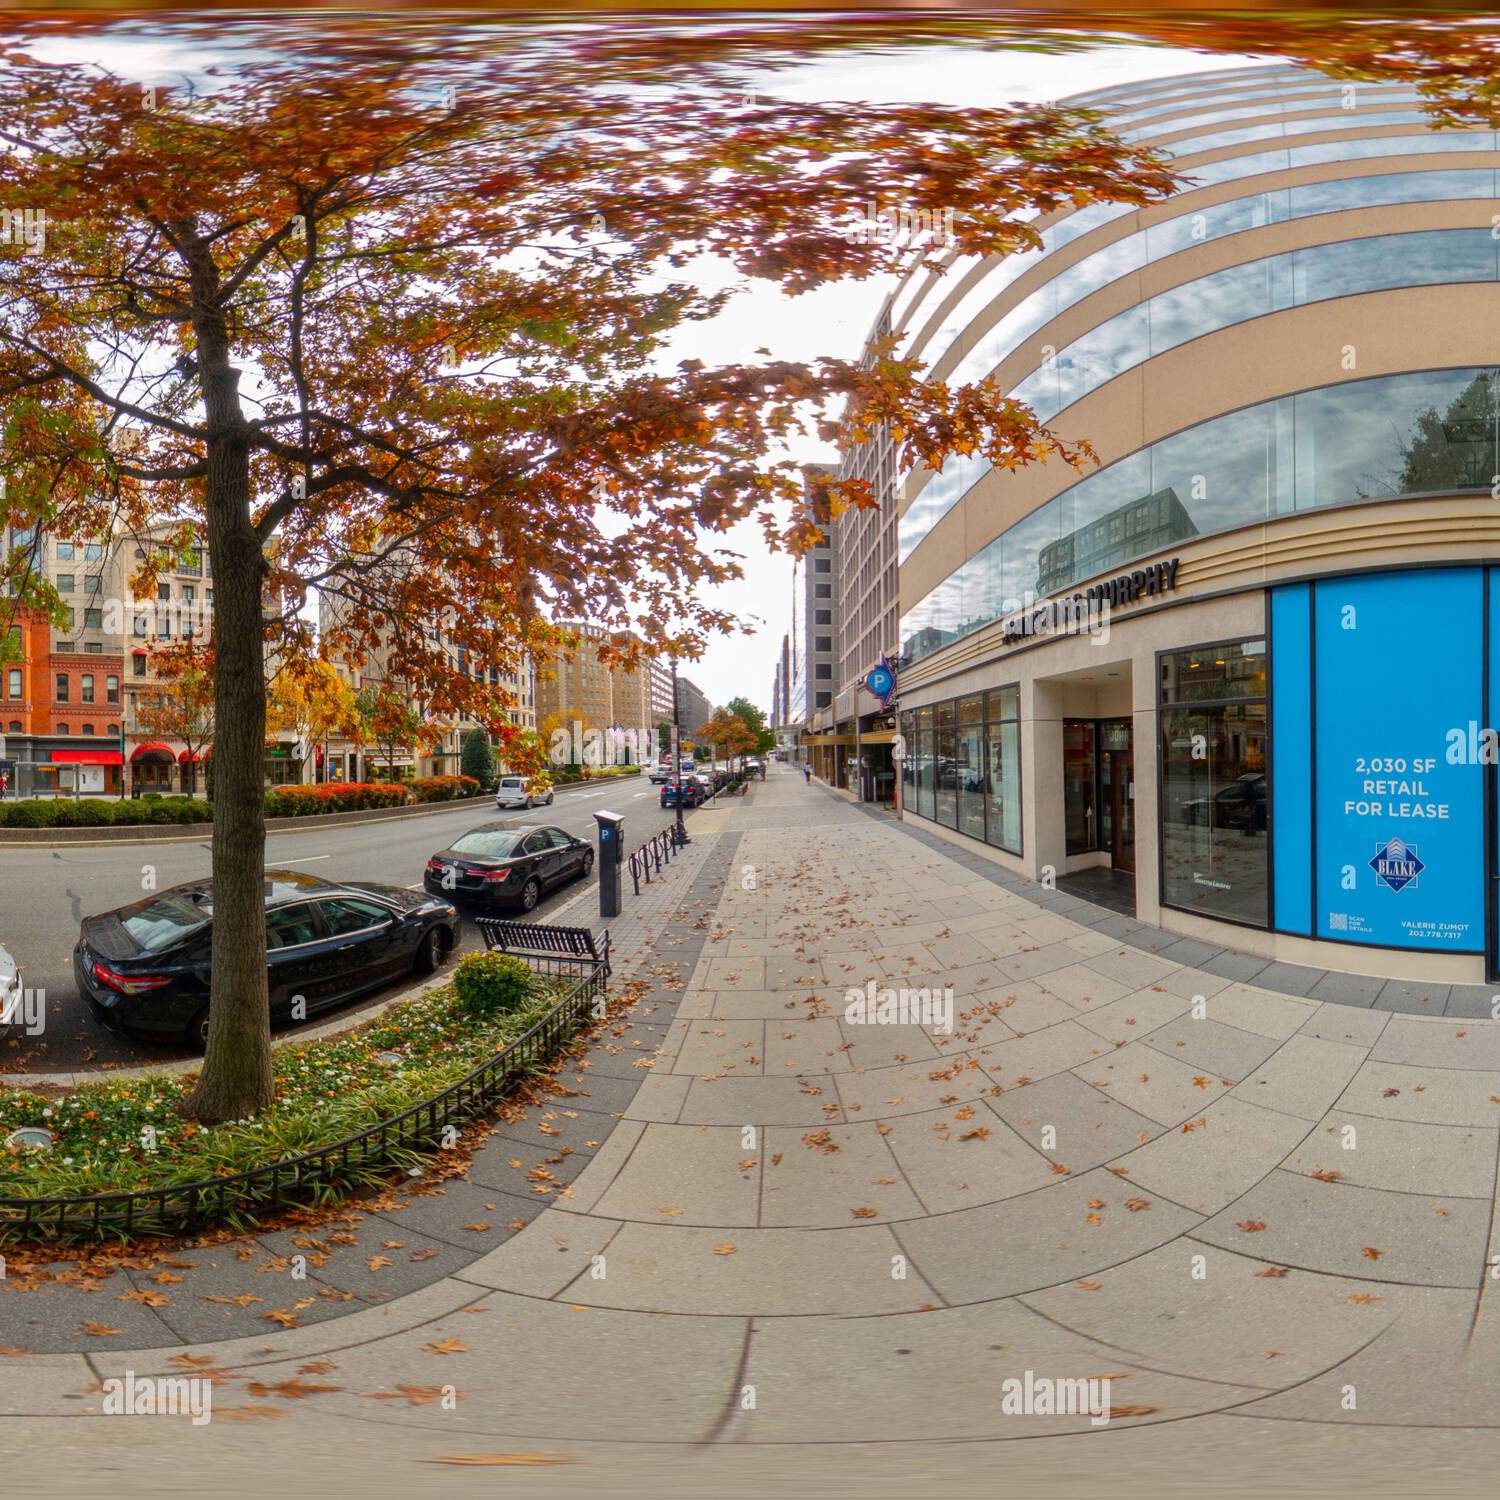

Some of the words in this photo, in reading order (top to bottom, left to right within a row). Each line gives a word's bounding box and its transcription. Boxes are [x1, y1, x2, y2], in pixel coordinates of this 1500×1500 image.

[1087, 557, 1179, 614] MURPHY
[874, 674, 885, 688] P
[1355, 758, 1407, 775] 2,030
[1413, 758, 1436, 774] SF
[1363, 780, 1429, 796] RETAIL
[1345, 801, 1382, 816] FOR
[1388, 803, 1450, 819] LEASE
[601, 829, 609, 840] P
[1378, 859, 1416, 877] BLAKE
[1401, 921, 1436, 929] VALERIE
[1439, 923, 1469, 931] ZUMOT
